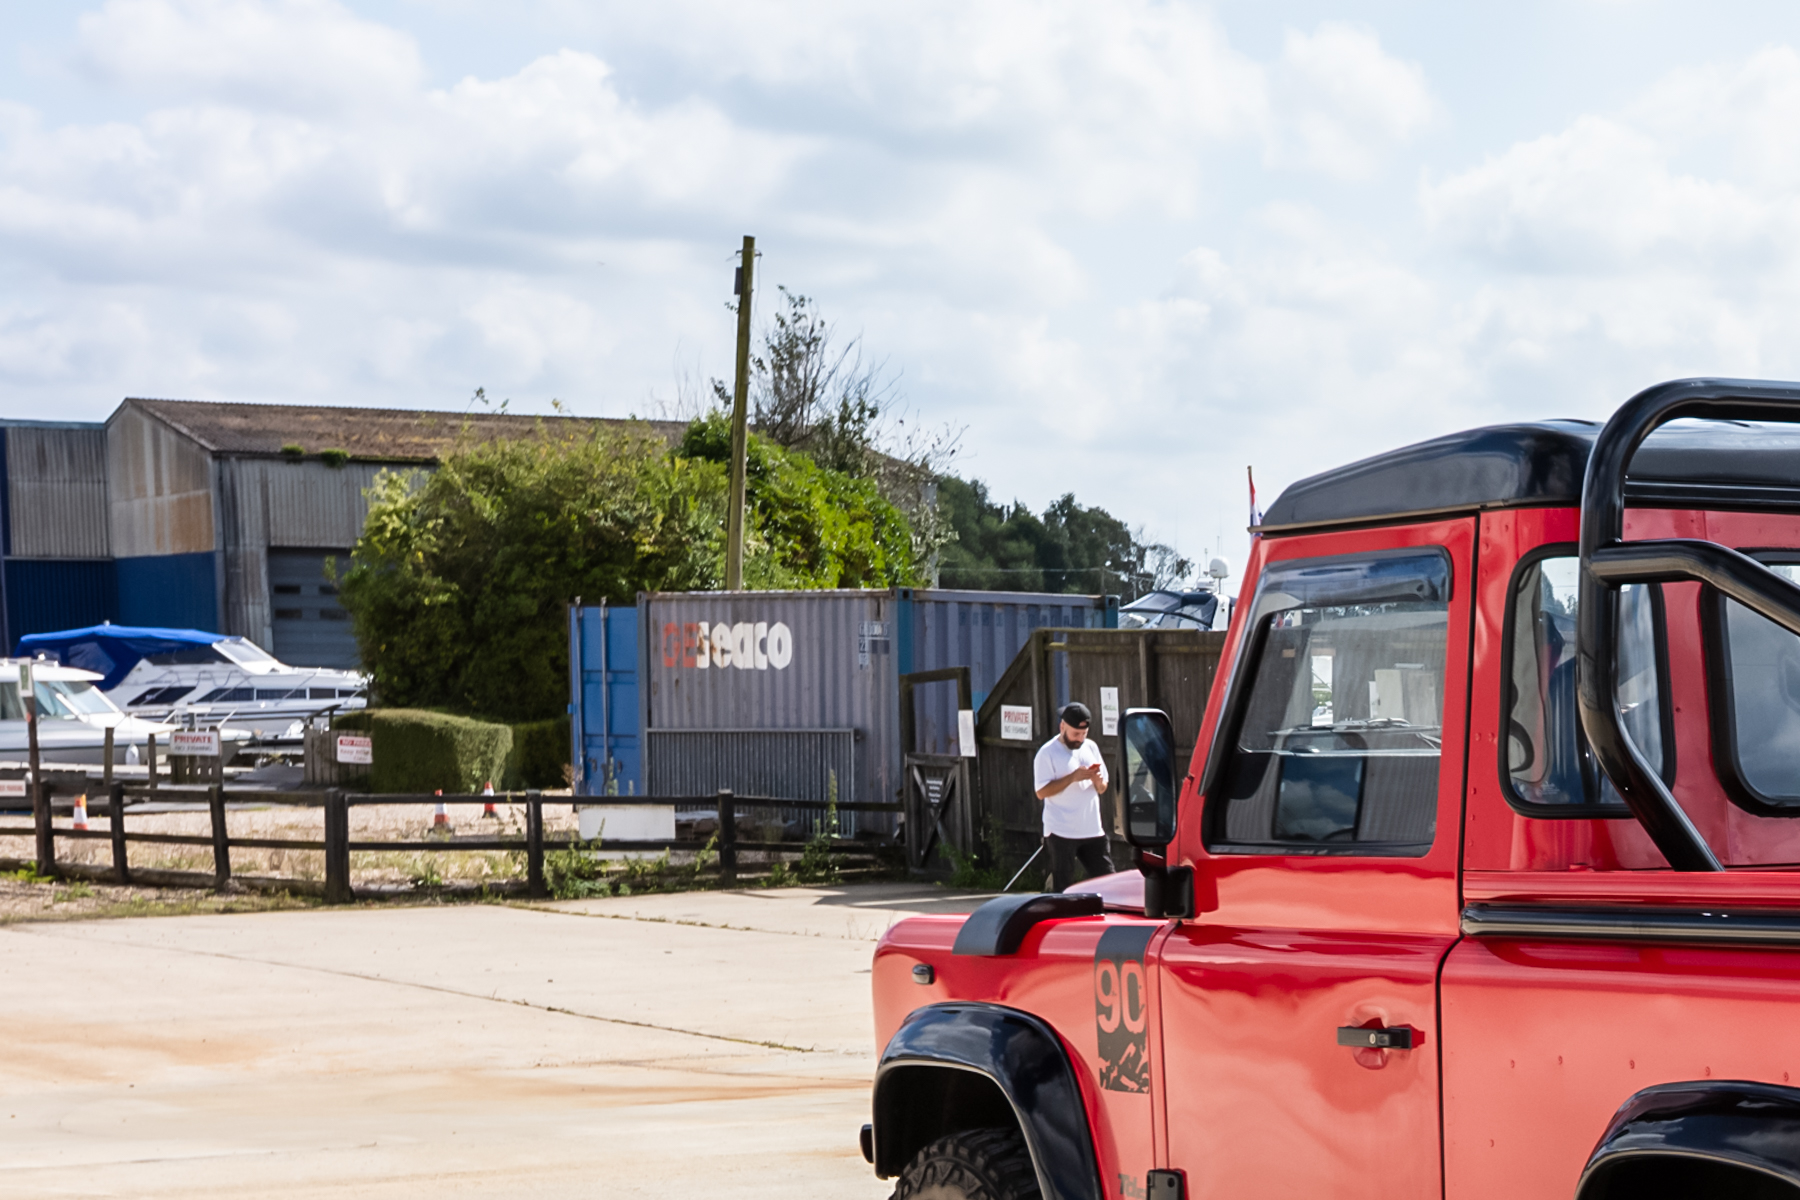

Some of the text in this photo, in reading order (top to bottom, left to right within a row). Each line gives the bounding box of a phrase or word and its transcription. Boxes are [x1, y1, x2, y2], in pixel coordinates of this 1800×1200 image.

[1004, 711, 1029, 723] PRIVATE
[174, 734, 213, 743] PRIVATE
[1096, 958, 1147, 1034] 90
